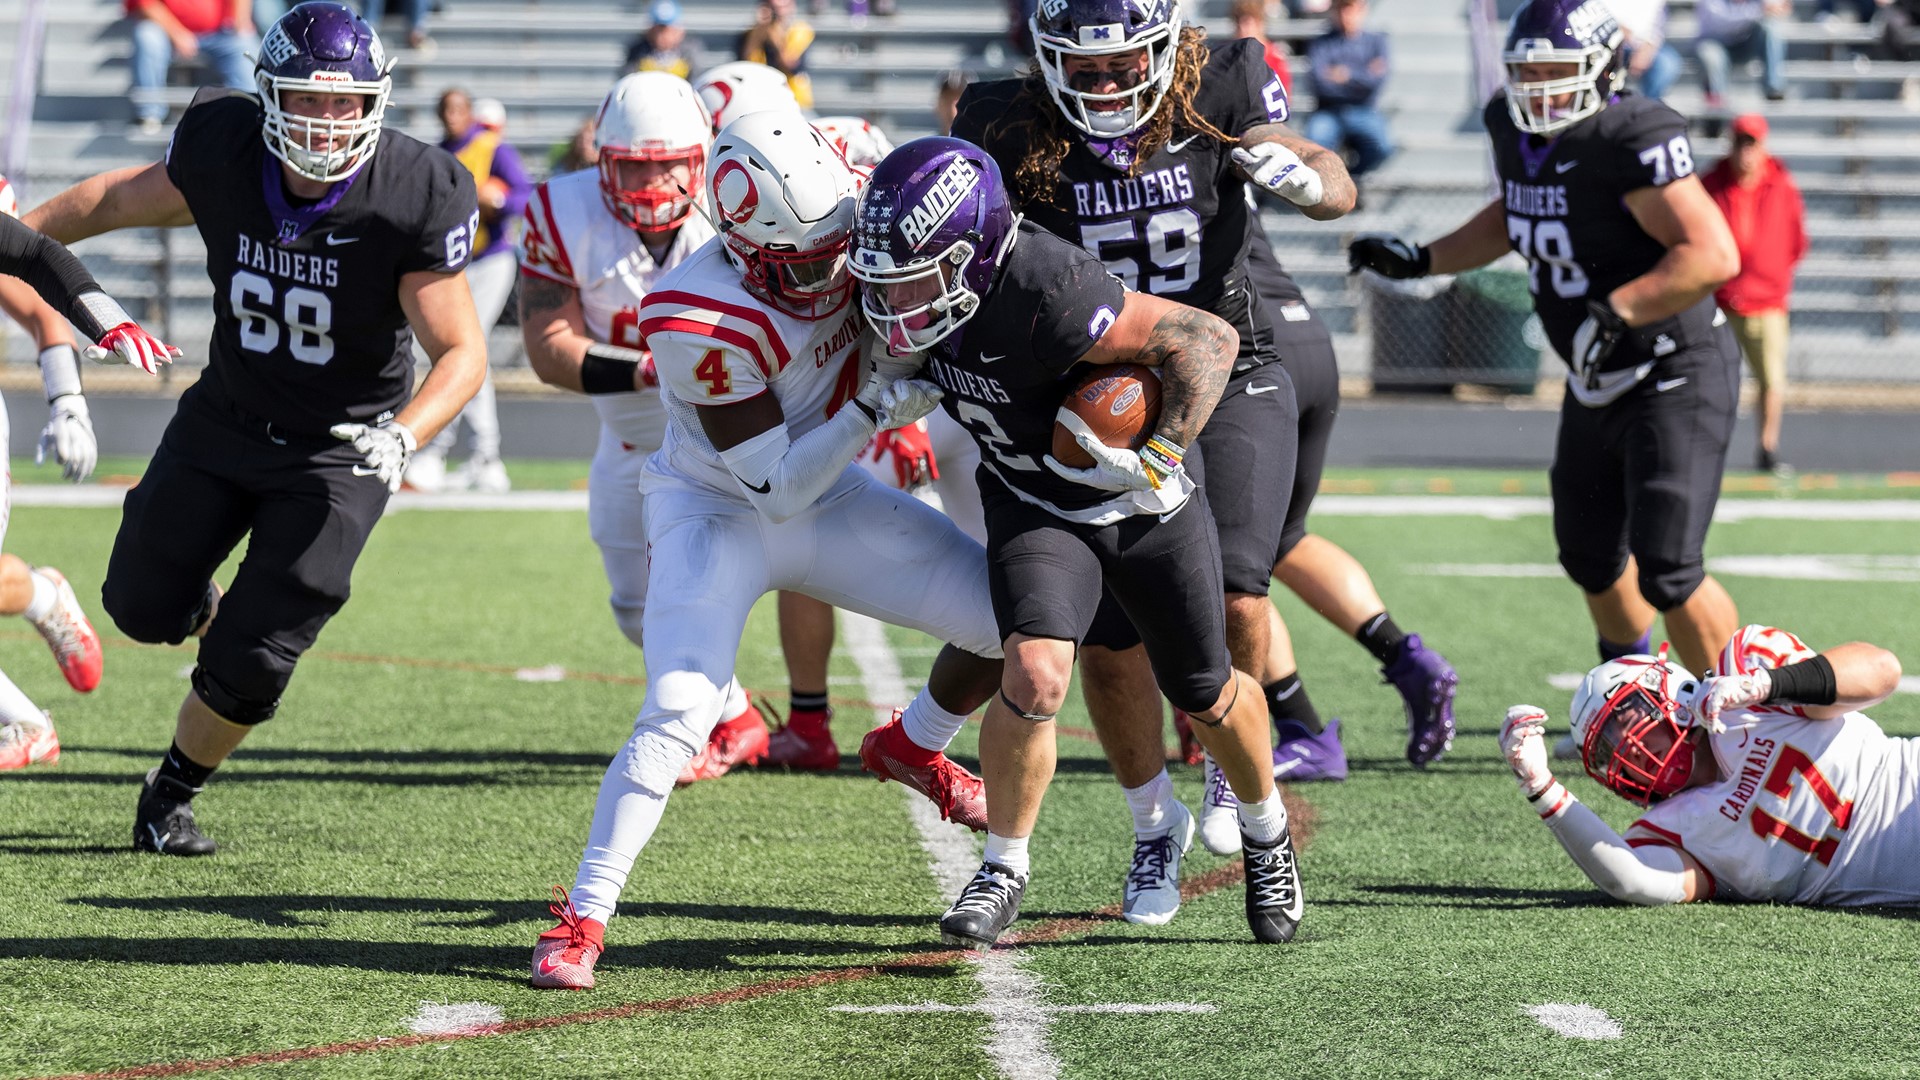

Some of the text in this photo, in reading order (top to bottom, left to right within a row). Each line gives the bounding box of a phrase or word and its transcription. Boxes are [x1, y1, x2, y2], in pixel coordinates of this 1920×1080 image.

[1262, 73, 1290, 123] 5
[1638, 135, 1694, 186] 78
[899, 153, 978, 249] RAIDERS
[1073, 163, 1195, 216] RAIDERS
[1506, 183, 1569, 217] RAIDERS
[279, 218, 299, 241] M
[812, 228, 840, 247] CARDS
[1079, 206, 1202, 295] 59
[237, 233, 338, 288] RAIDERS
[862, 252, 878, 267] M
[1507, 218, 1589, 298] 78
[230, 269, 335, 366] 68
[814, 312, 869, 370] CARDINA
[694, 348, 732, 396] 4
[1113, 384, 1139, 412] GST
[957, 400, 1042, 472] 2
[1718, 737, 1776, 823] CARDINALS
[1751, 743, 1854, 867] 17
